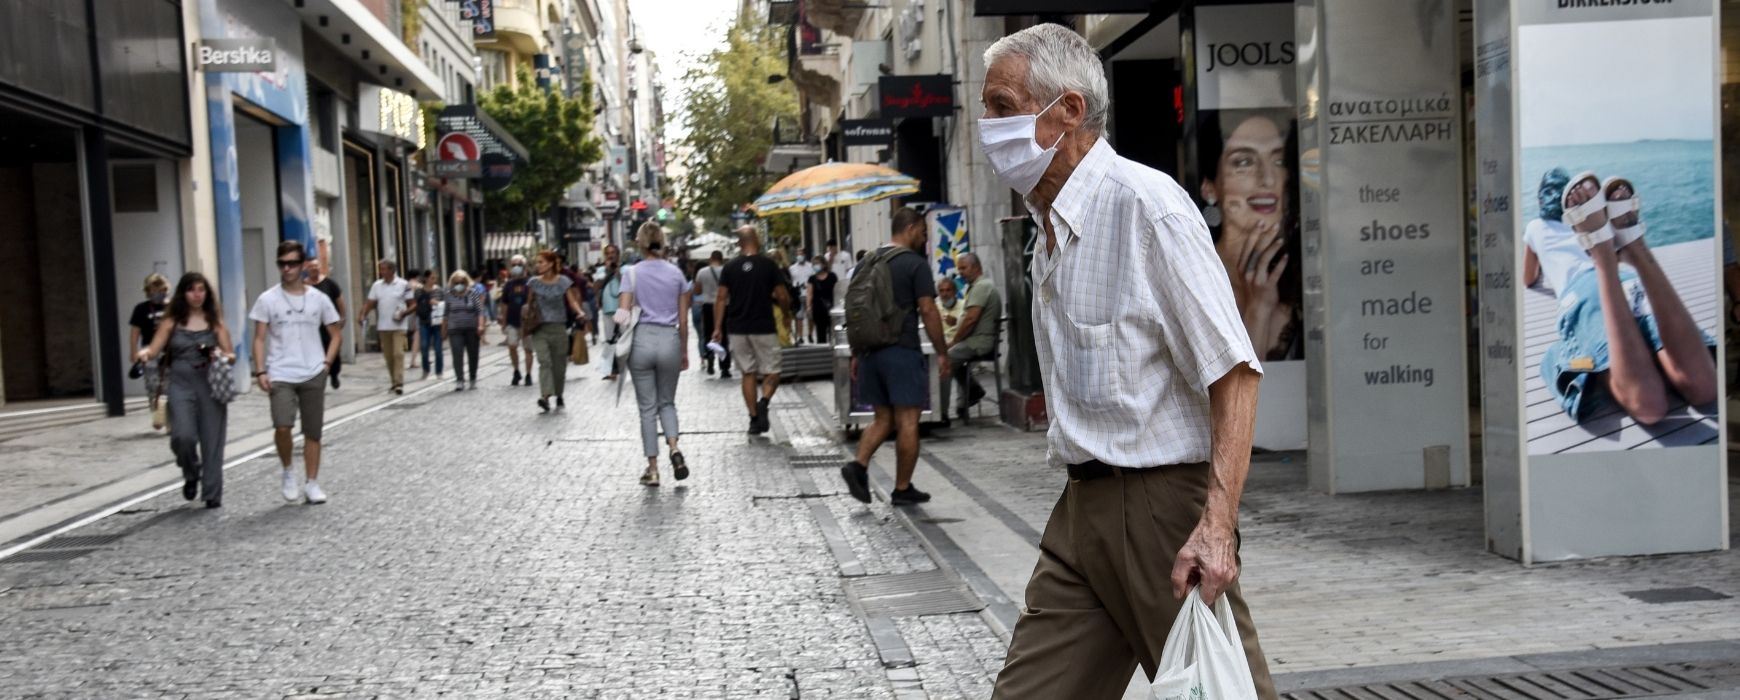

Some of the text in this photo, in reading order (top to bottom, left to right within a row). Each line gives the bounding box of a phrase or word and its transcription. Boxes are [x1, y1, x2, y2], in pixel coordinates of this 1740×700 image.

[200, 46, 272, 64] Bershka
[1206, 41, 1295, 72] JOOLS
[1329, 92, 1452, 116] ανατομικά
[1329, 122, 1451, 145] ΣΑΚΕΛΛΑΡΗ
[1359, 184, 1400, 203] these
[1360, 219, 1430, 242] shoes
[1360, 259, 1394, 276] are
[1361, 290, 1432, 316] made
[1363, 332, 1389, 351] for
[1364, 364, 1434, 387] walking
